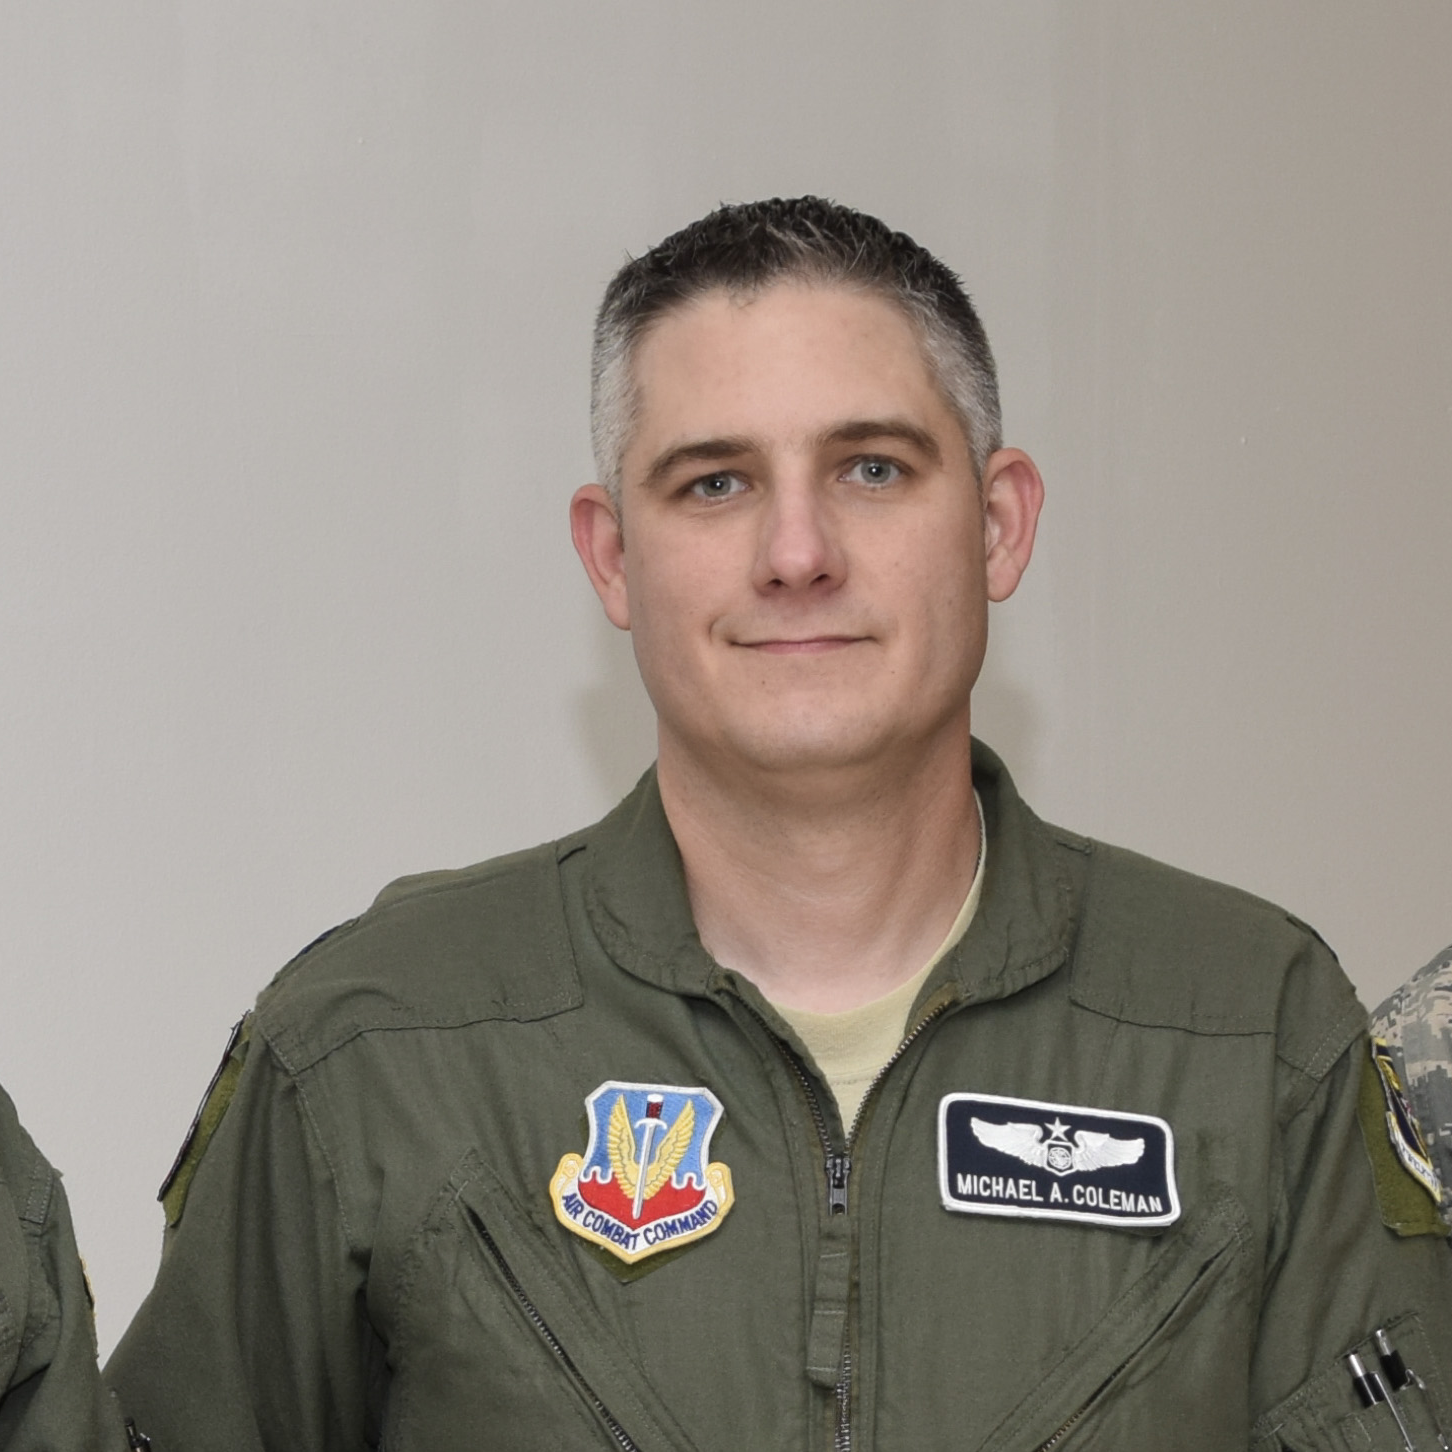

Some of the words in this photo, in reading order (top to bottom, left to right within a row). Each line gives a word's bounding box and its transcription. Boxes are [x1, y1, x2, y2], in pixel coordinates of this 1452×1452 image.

[957, 1173, 1045, 1203] MICHAEL
[1049, 1183, 1070, 1203] A.
[1073, 1185, 1163, 1213] COLEMAN
[561, 1193, 582, 1220] AIR
[581, 1210, 639, 1250] COMBAT
[643, 1199, 718, 1245] COMMAND
